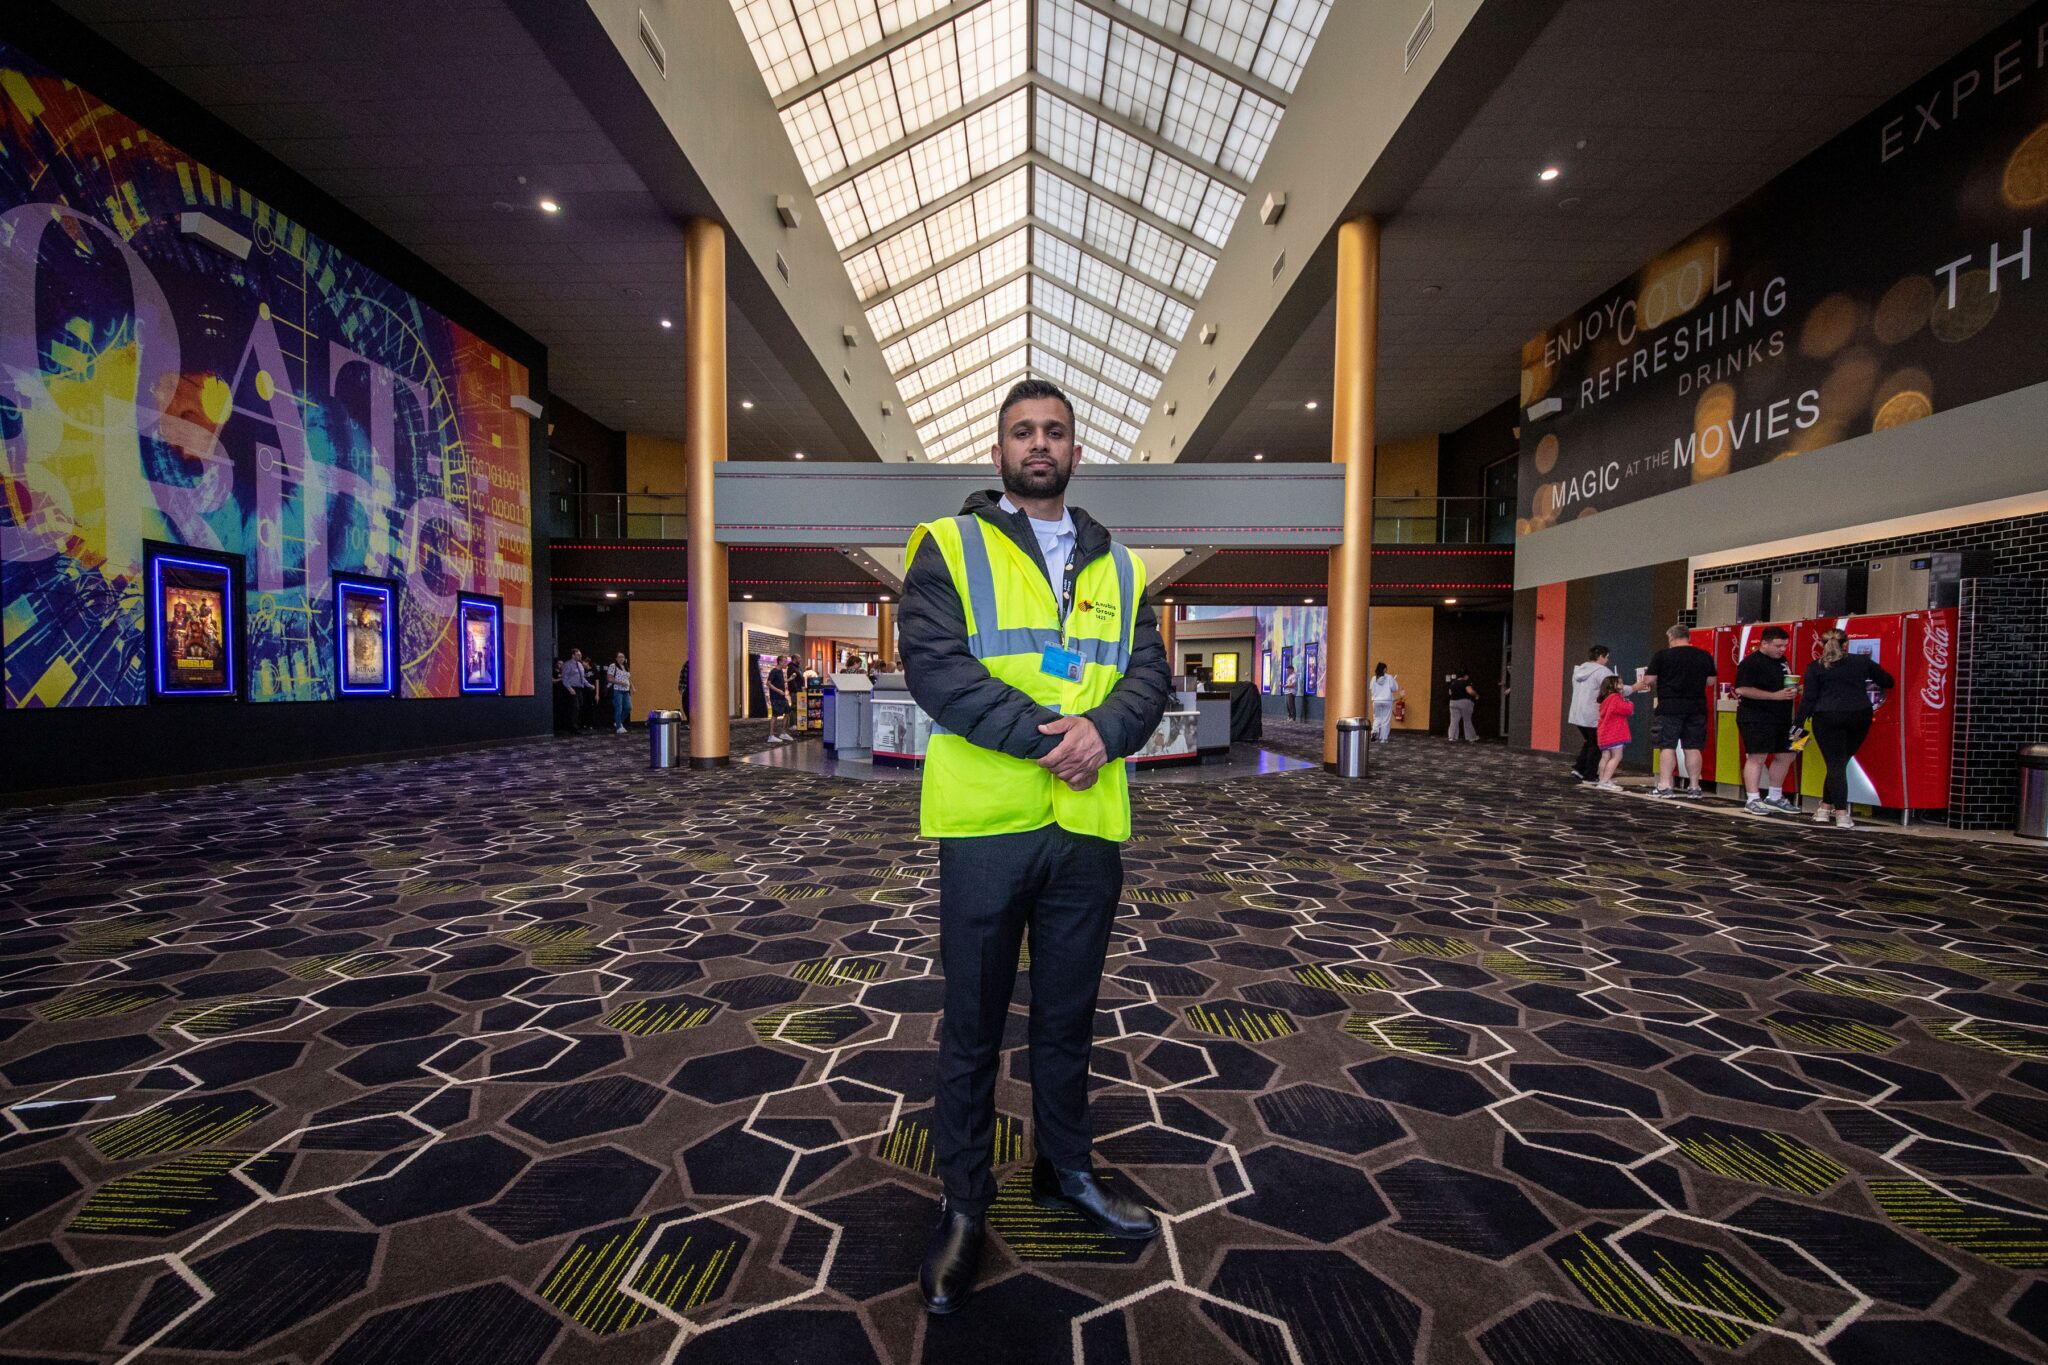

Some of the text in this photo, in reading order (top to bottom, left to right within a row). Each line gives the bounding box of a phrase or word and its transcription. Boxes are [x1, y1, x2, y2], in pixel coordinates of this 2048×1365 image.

[1544, 245, 1732, 369] ENJOY COOL
[1934, 227, 2032, 310] TH
[1581, 276, 1787, 409] REFRESHING
[1678, 330, 1785, 397] DRINKS
[1552, 389, 1821, 510] MAGIC AT THE MOVIES
[1095, 601, 1117, 611] Anubis
[1095, 607, 1116, 618] Group
